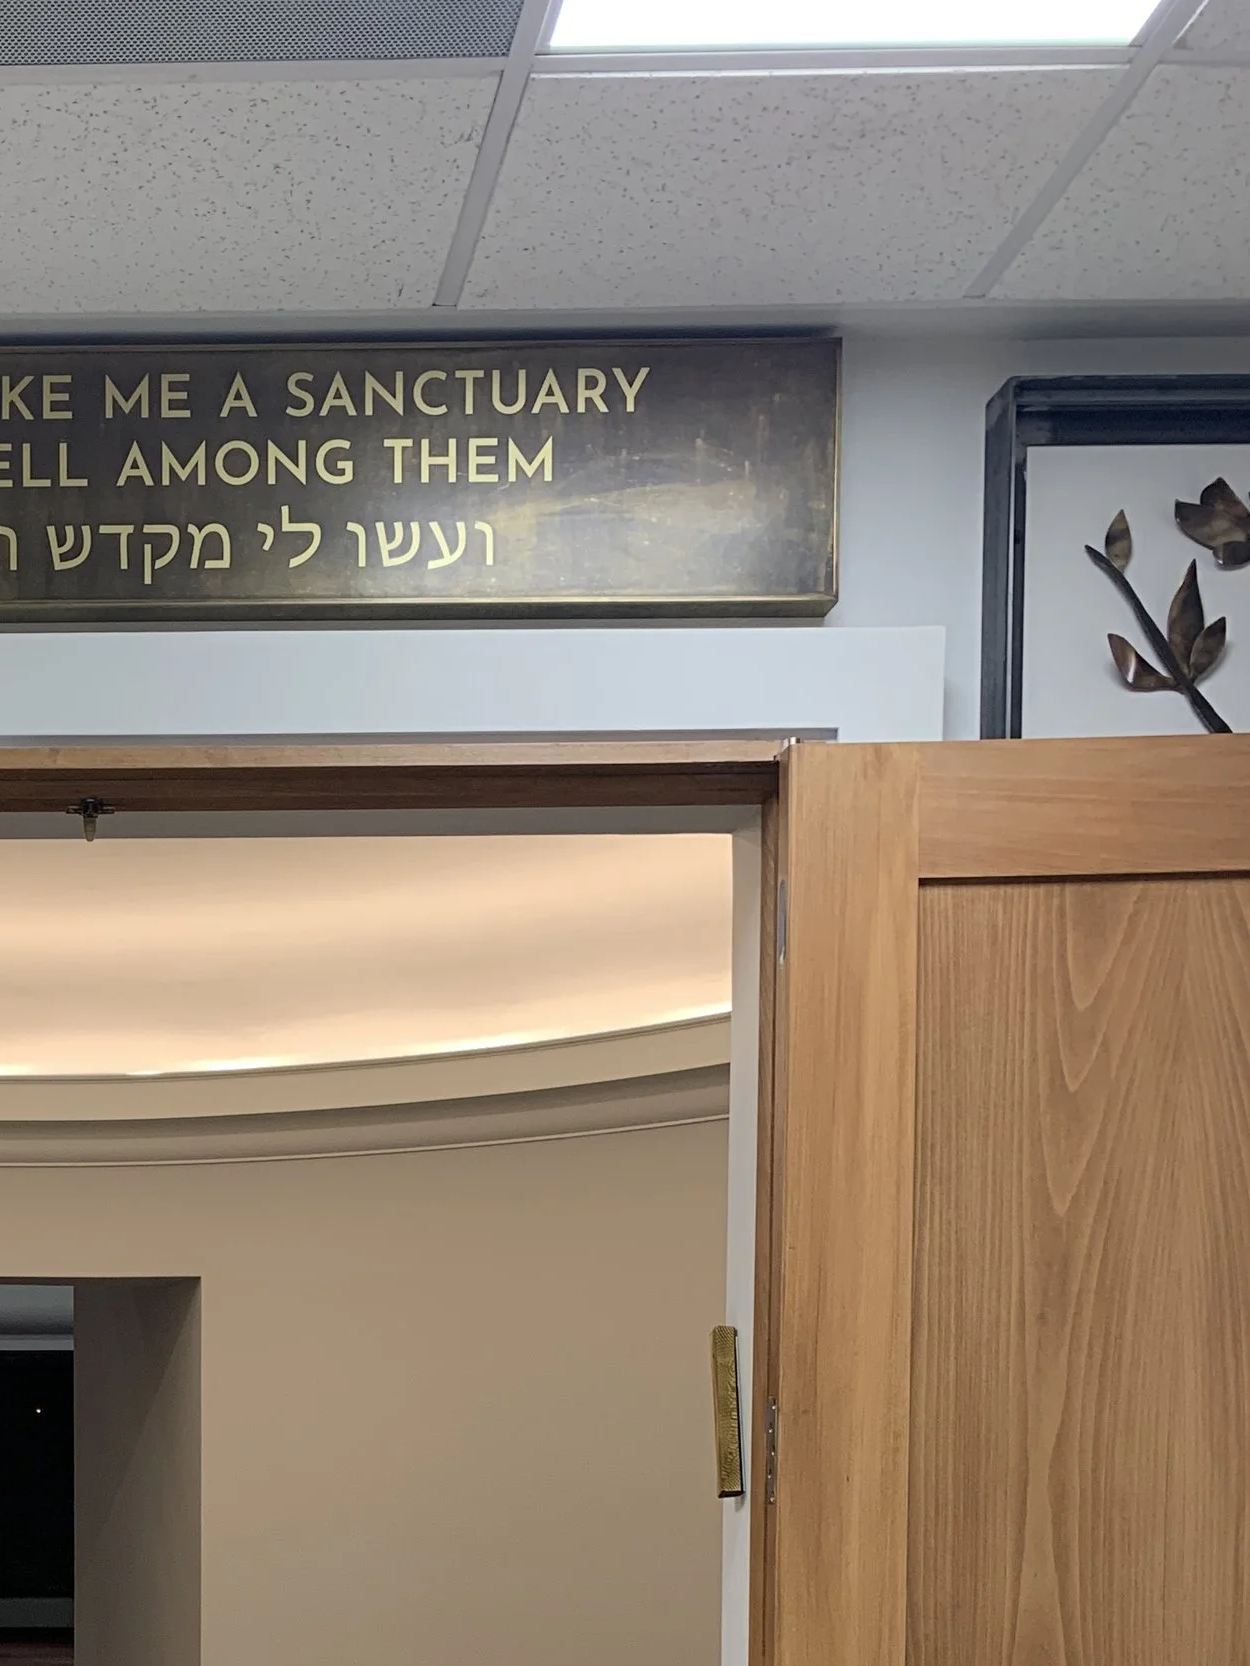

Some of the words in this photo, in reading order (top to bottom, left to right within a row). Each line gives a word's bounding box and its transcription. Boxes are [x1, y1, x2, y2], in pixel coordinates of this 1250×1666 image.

[105, 373, 191, 419] ME
[219, 371, 258, 418] A
[285, 367, 650, 417] SANCTUARY
[116, 438, 354, 487] AMONG
[383, 435, 553, 484] THEM
[46, 522, 231, 585] מקדש
[256, 504, 322, 569] לי
[346, 520, 494, 569] ועשו
